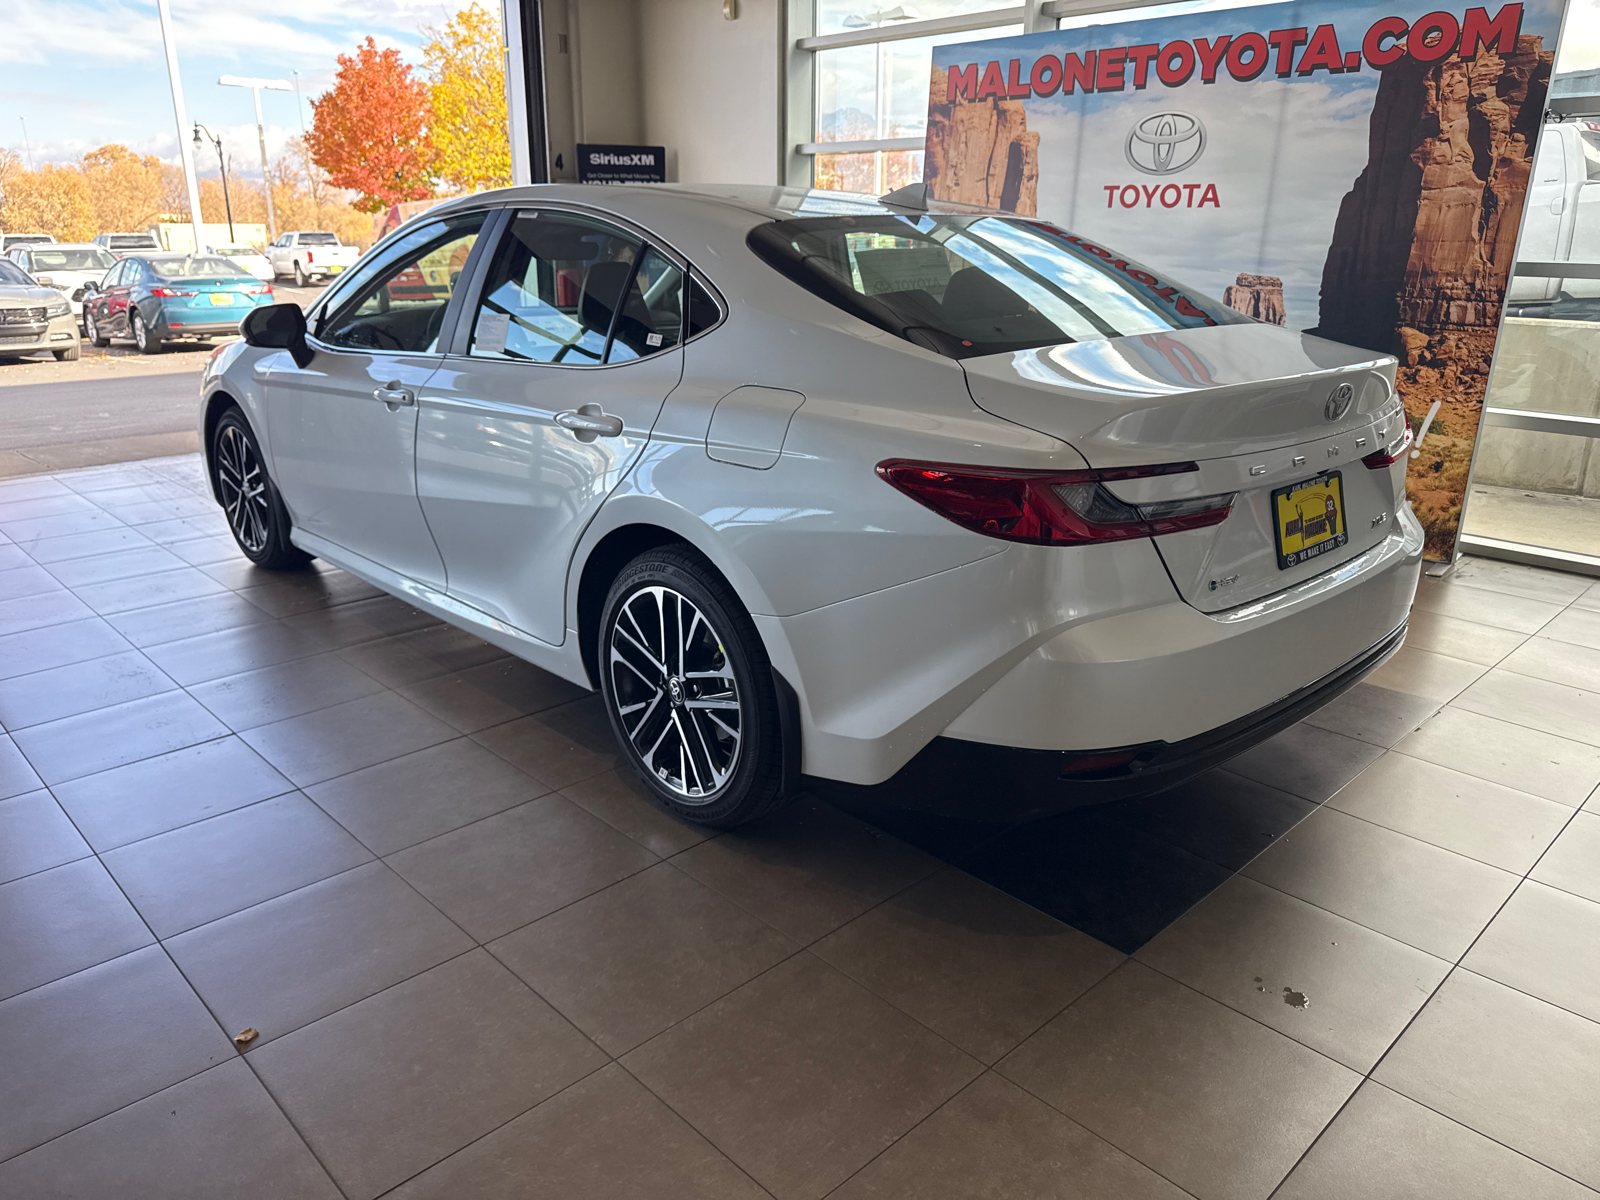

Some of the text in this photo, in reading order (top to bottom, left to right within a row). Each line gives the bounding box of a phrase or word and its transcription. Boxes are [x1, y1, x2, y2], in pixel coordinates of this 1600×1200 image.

[947, 3, 1524, 104] MALONETOYOTA.COM
[589, 152, 655, 166] SiriusXM
[1103, 183, 1221, 209] TOYOTA
[1249, 428, 1387, 477] CAMRY
[1326, 499, 1334, 511] 32
[1300, 550, 1308, 560] WE
[1307, 545, 1320, 558] MAKE
[1324, 539, 1335, 550] EASY
